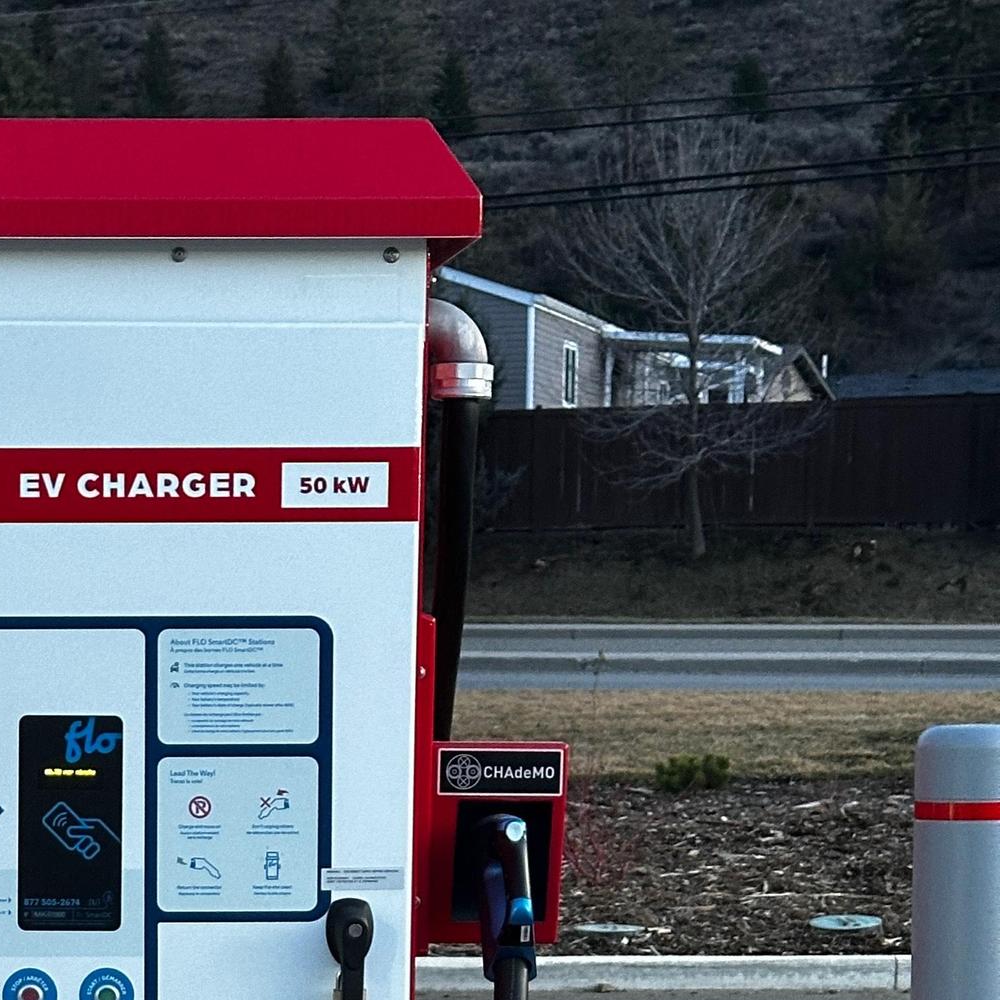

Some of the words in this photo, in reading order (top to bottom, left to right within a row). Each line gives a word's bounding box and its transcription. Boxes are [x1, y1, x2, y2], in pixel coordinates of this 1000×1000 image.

[19, 473, 66, 498] EV
[77, 472, 256, 498] CHARGER
[299, 476, 327, 494] 50
[333, 476, 370, 494] kW
[64, 716, 122, 763] flo
[483, 765, 555, 779] CHAdeMO
[23, 898, 40, 906] 877
[11, 977, 23, 992] STOP
[87, 978, 98, 995] START
